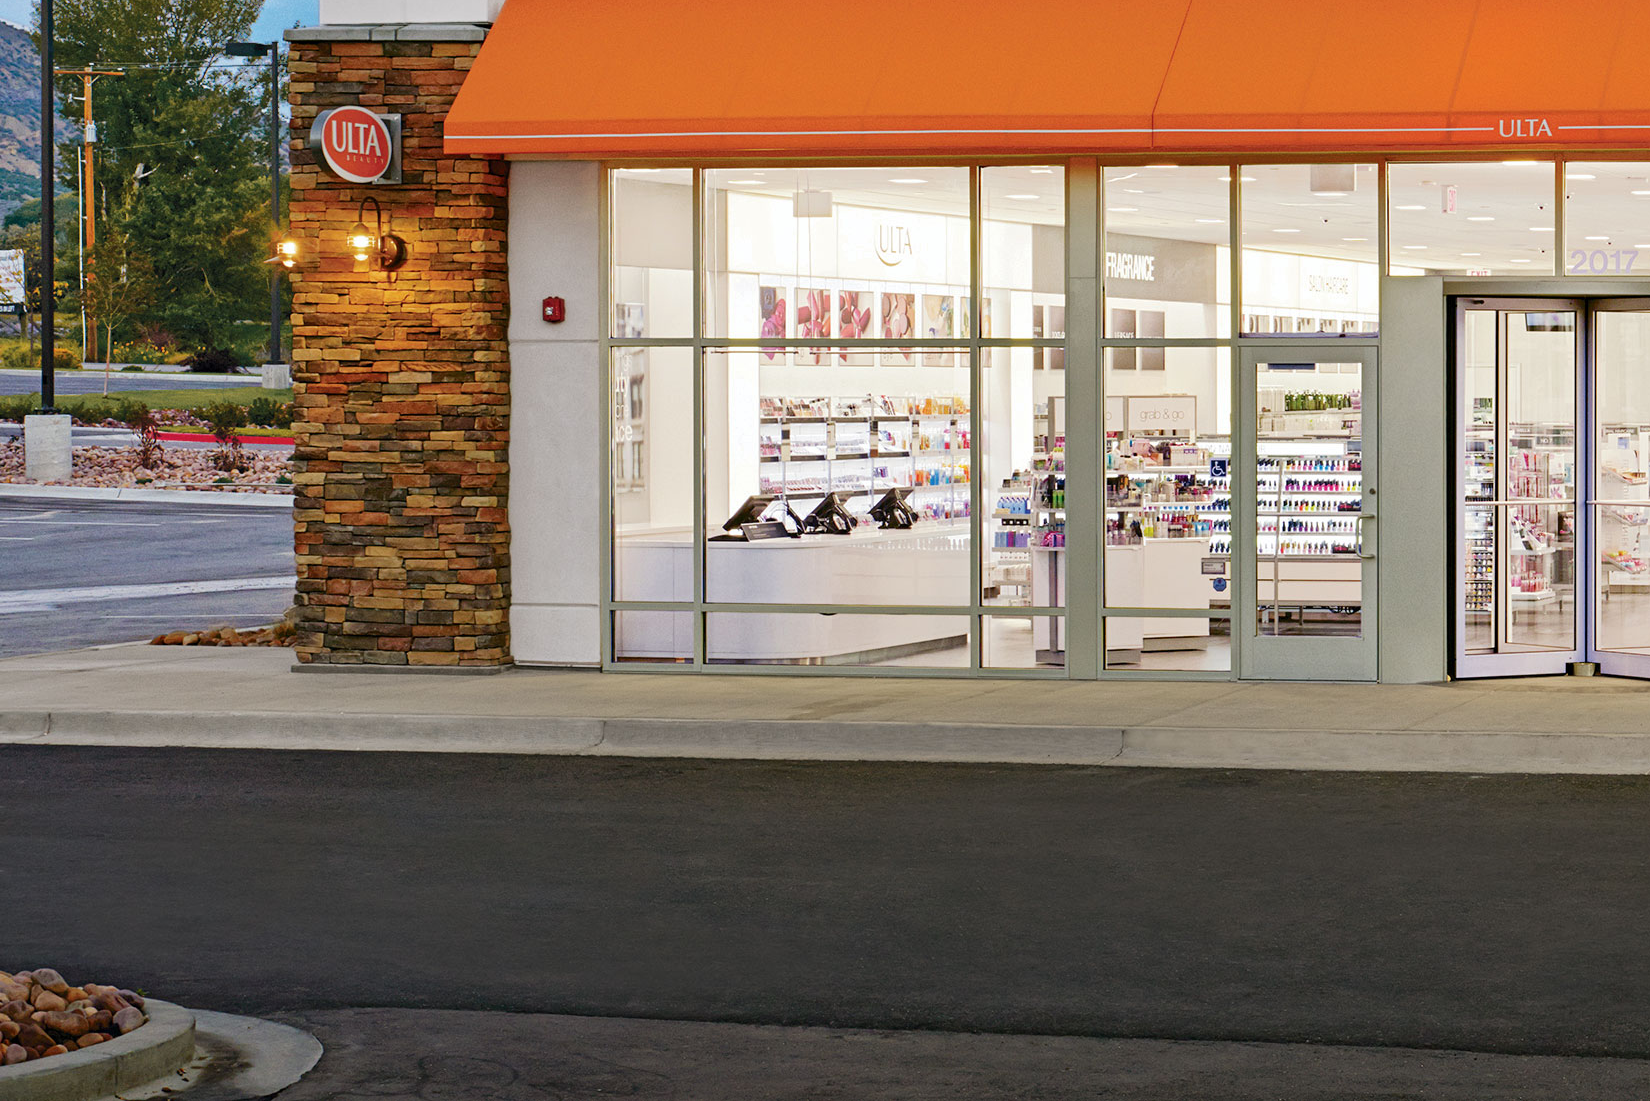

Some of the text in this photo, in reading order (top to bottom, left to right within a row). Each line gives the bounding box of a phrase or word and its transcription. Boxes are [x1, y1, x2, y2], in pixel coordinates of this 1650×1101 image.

[331, 119, 382, 157] ULTA
[1499, 118, 1553, 138] ULTA
[346, 154, 385, 164] BEAUTY
[879, 224, 913, 255] ULTA
[1105, 251, 1155, 281] FRAGRANCE
[1570, 249, 1639, 275] 2017
